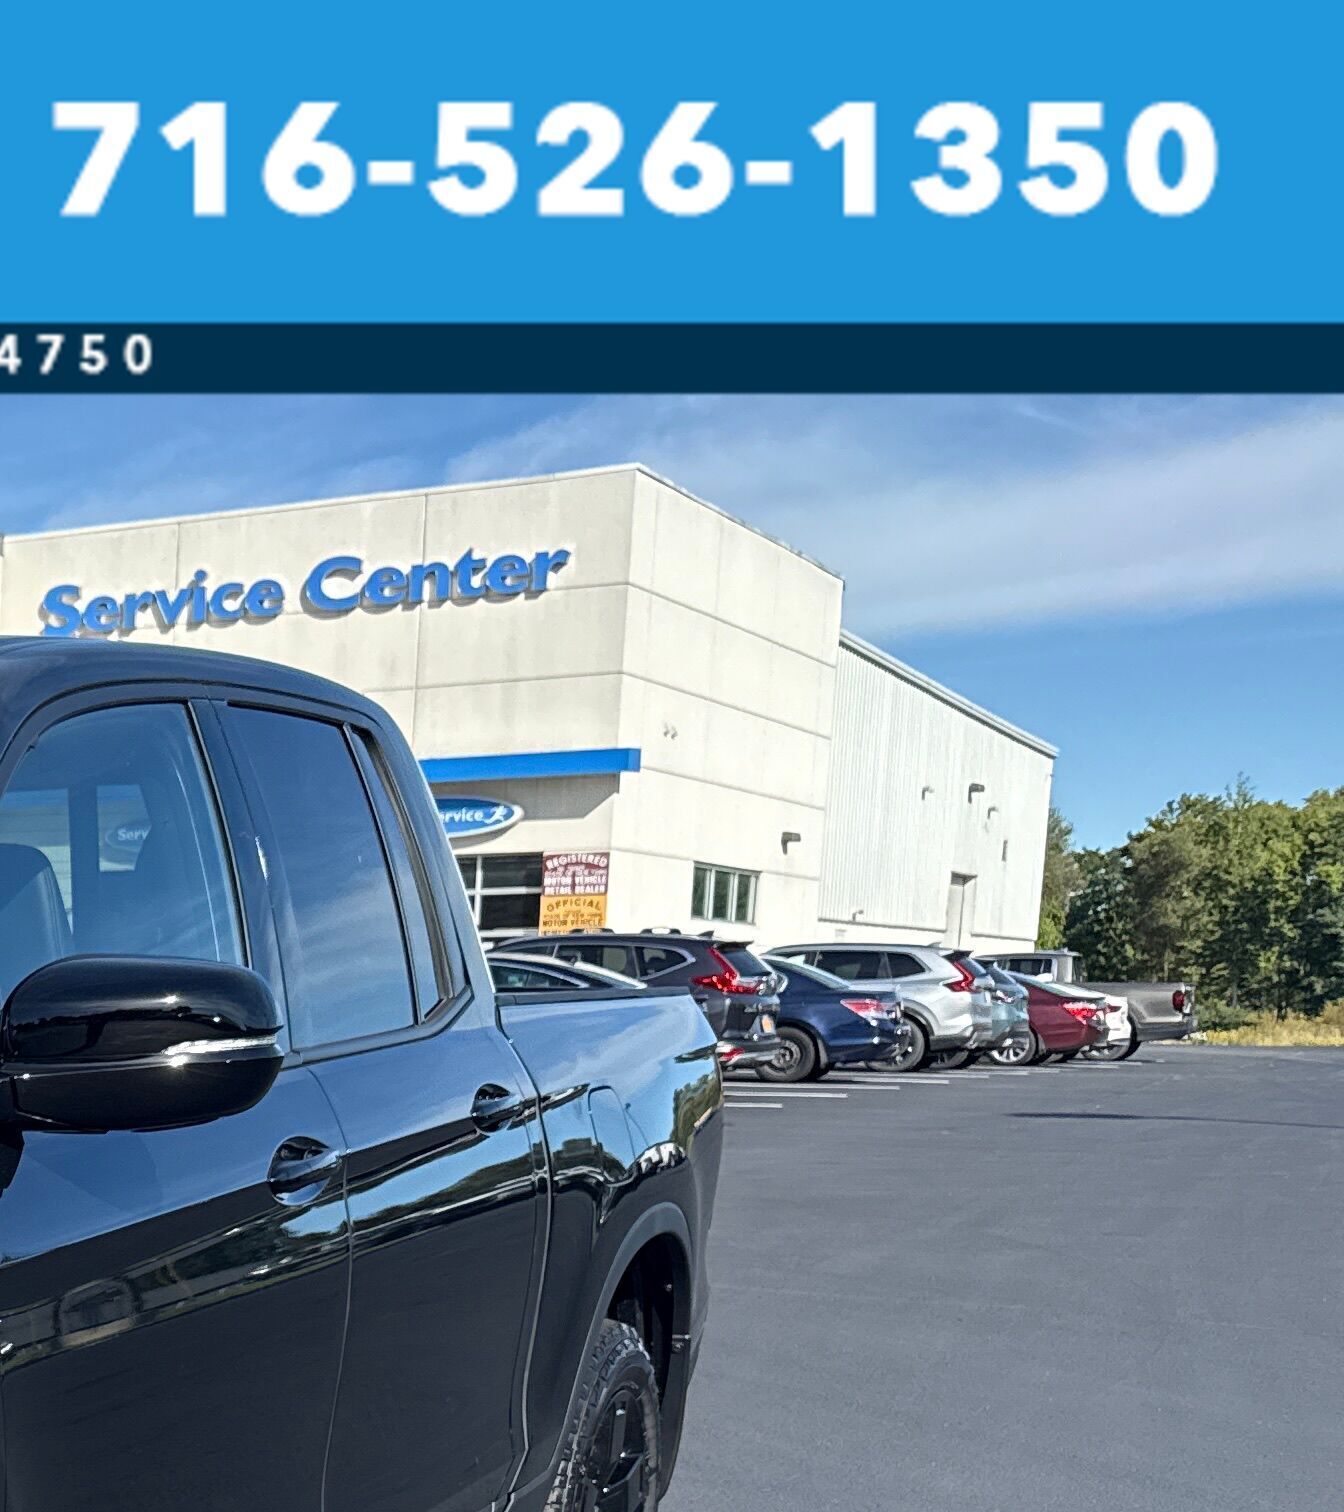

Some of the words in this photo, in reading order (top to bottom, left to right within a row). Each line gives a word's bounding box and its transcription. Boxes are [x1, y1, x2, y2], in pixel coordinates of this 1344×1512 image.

[41, 569, 285, 638] Service
[304, 547, 572, 613] Center
[545, 854, 608, 870] REGISTERED
[546, 898, 602, 912] OFFICIAL
